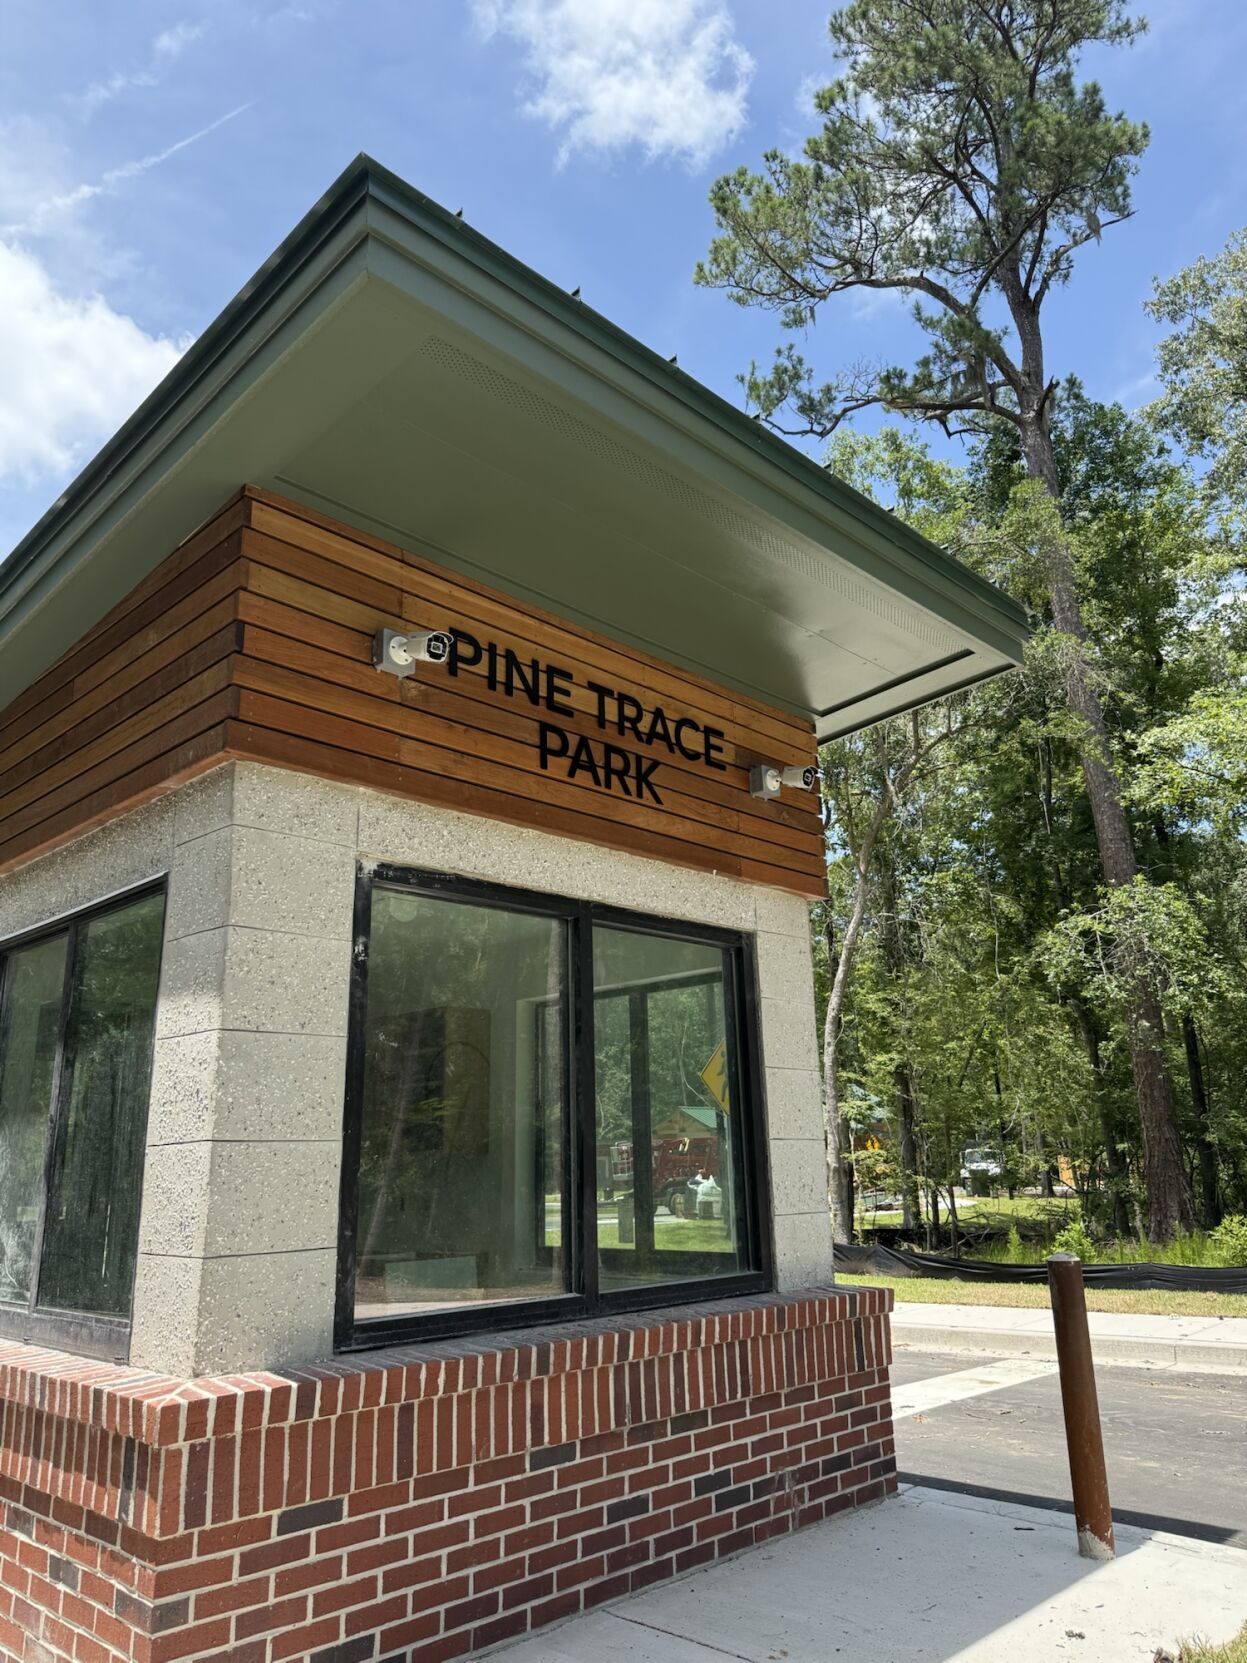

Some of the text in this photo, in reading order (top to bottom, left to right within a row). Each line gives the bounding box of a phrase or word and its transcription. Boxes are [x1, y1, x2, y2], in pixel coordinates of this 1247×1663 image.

[448, 627, 727, 771] PINE TRACE
[539, 722, 663, 805] PARK
